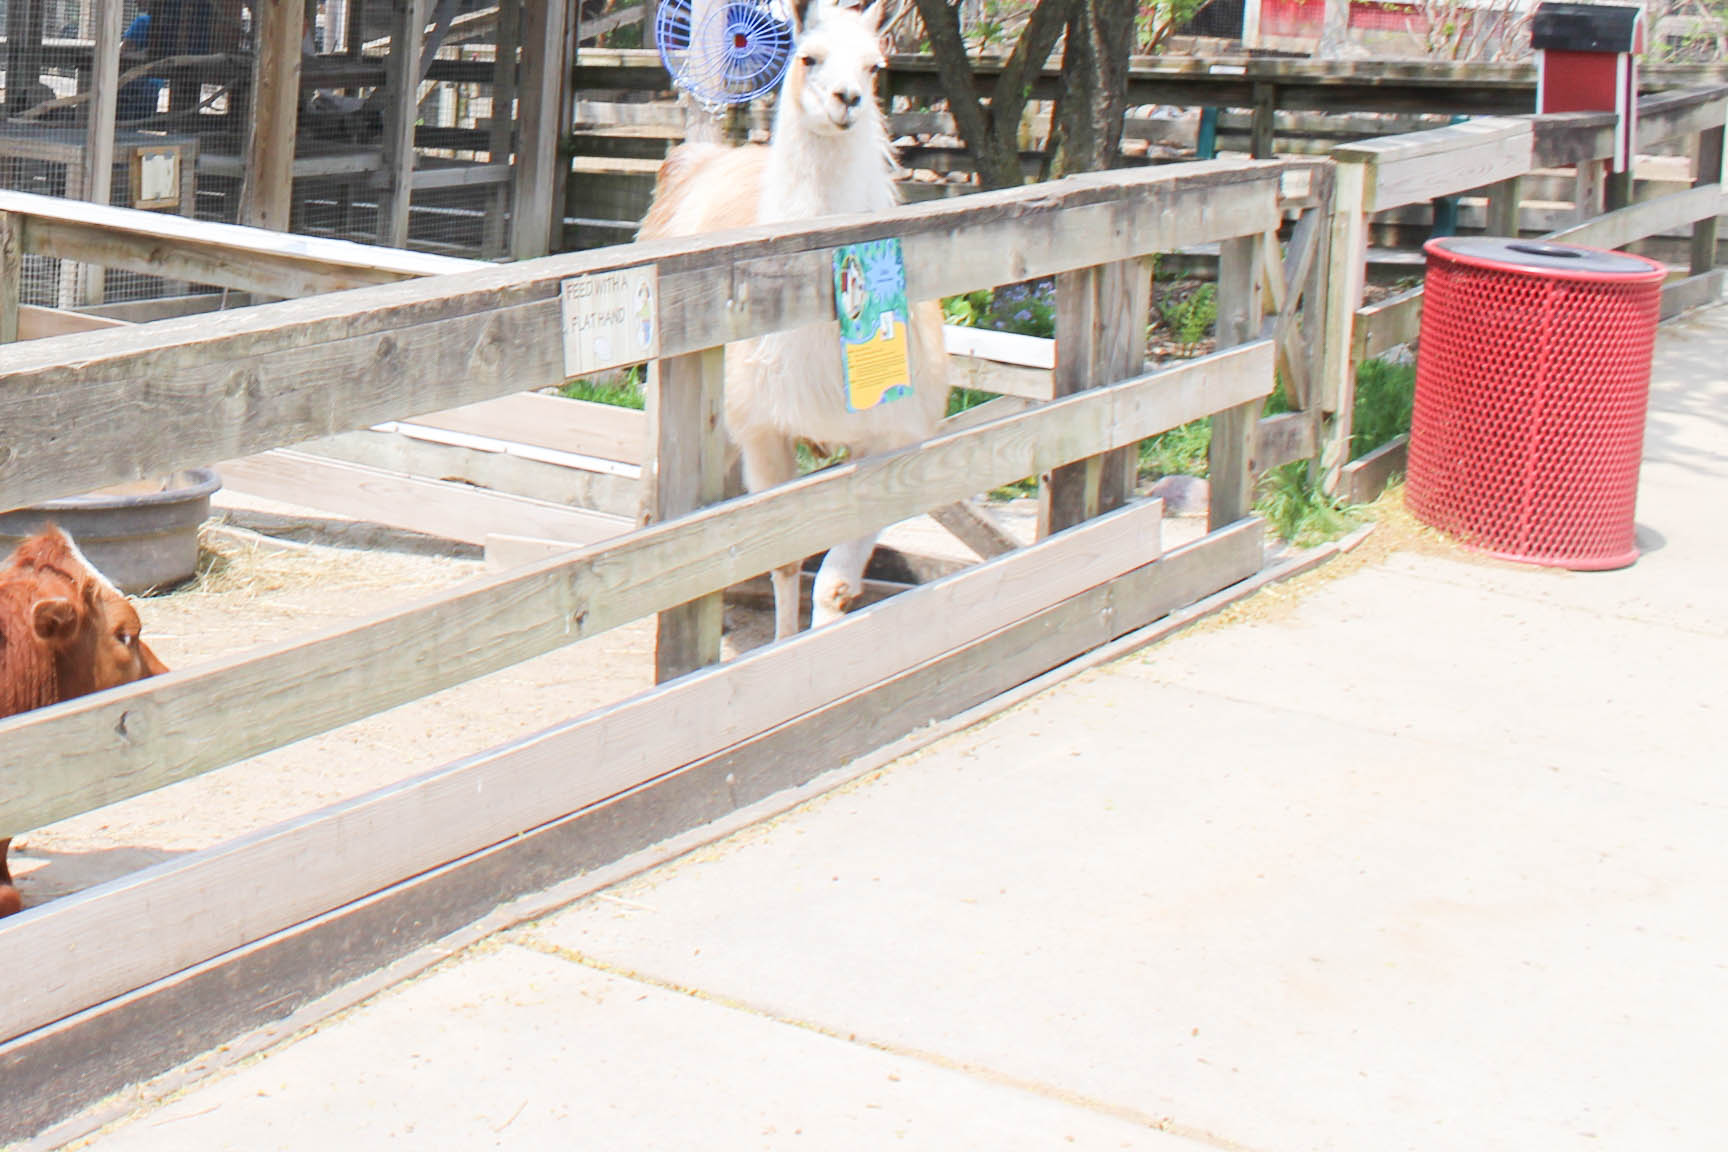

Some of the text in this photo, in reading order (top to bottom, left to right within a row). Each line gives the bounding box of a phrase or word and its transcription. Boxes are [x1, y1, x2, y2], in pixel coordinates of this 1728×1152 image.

[566, 274, 628, 299] FEED WITH A
[571, 306, 625, 333] FLAT HAND
